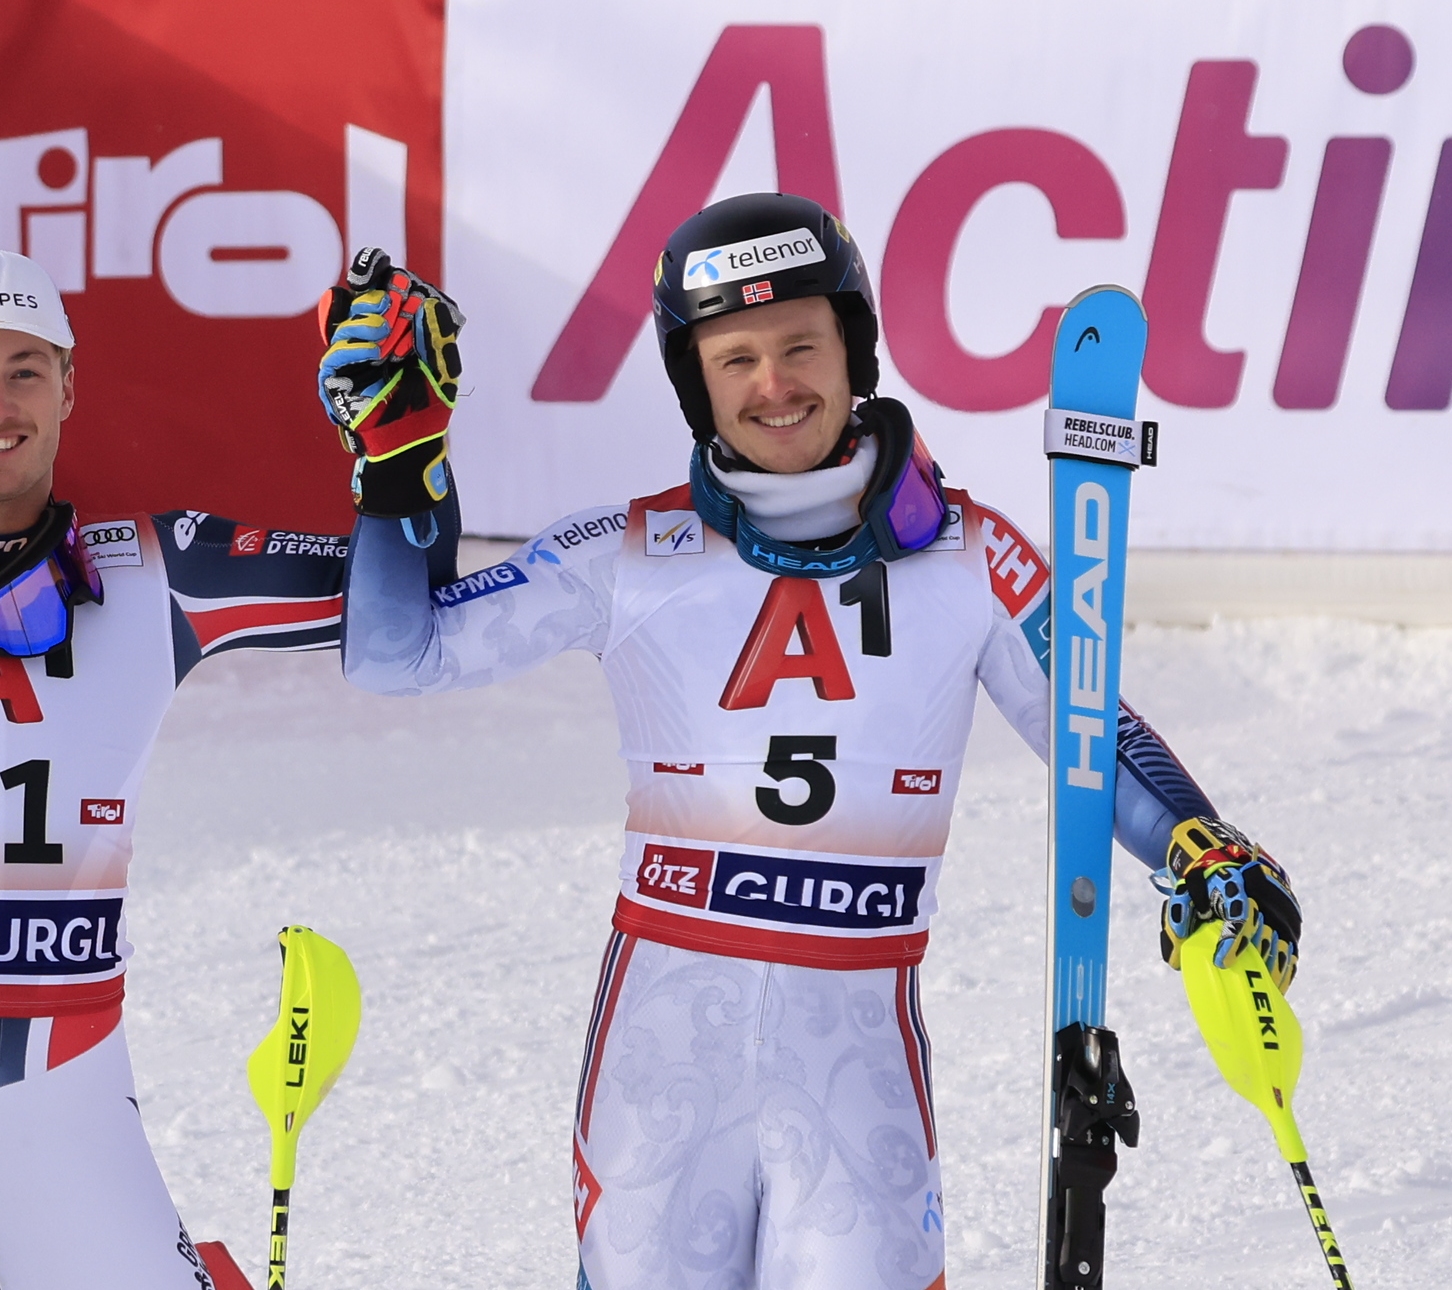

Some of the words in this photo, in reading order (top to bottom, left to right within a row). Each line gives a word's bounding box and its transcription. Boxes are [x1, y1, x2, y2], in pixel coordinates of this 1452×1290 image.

[727, 233, 818, 271] telenor
[1063, 416, 1136, 442] REBELSCLUB.
[1063, 433, 1117, 454] HEAD.COM
[1145, 425, 1156, 460] HEAD
[271, 531, 340, 544] CAISSE
[552, 512, 629, 550] teleno
[266, 541, 349, 557] D'EPARG
[751, 542, 857, 572] HEAD
[434, 563, 516, 606] KPMG
[1067, 481, 1110, 791] HEAD
[754, 735, 837, 826] 5
[901, 774, 937, 791] Tirol
[87, 804, 121, 822] Tirol
[1245, 969, 1280, 1051] LEKI
[285, 1006, 309, 1089] LEKI
[1104, 1081, 1117, 1105] 14X
[1300, 1185, 1346, 1265] LEKI
